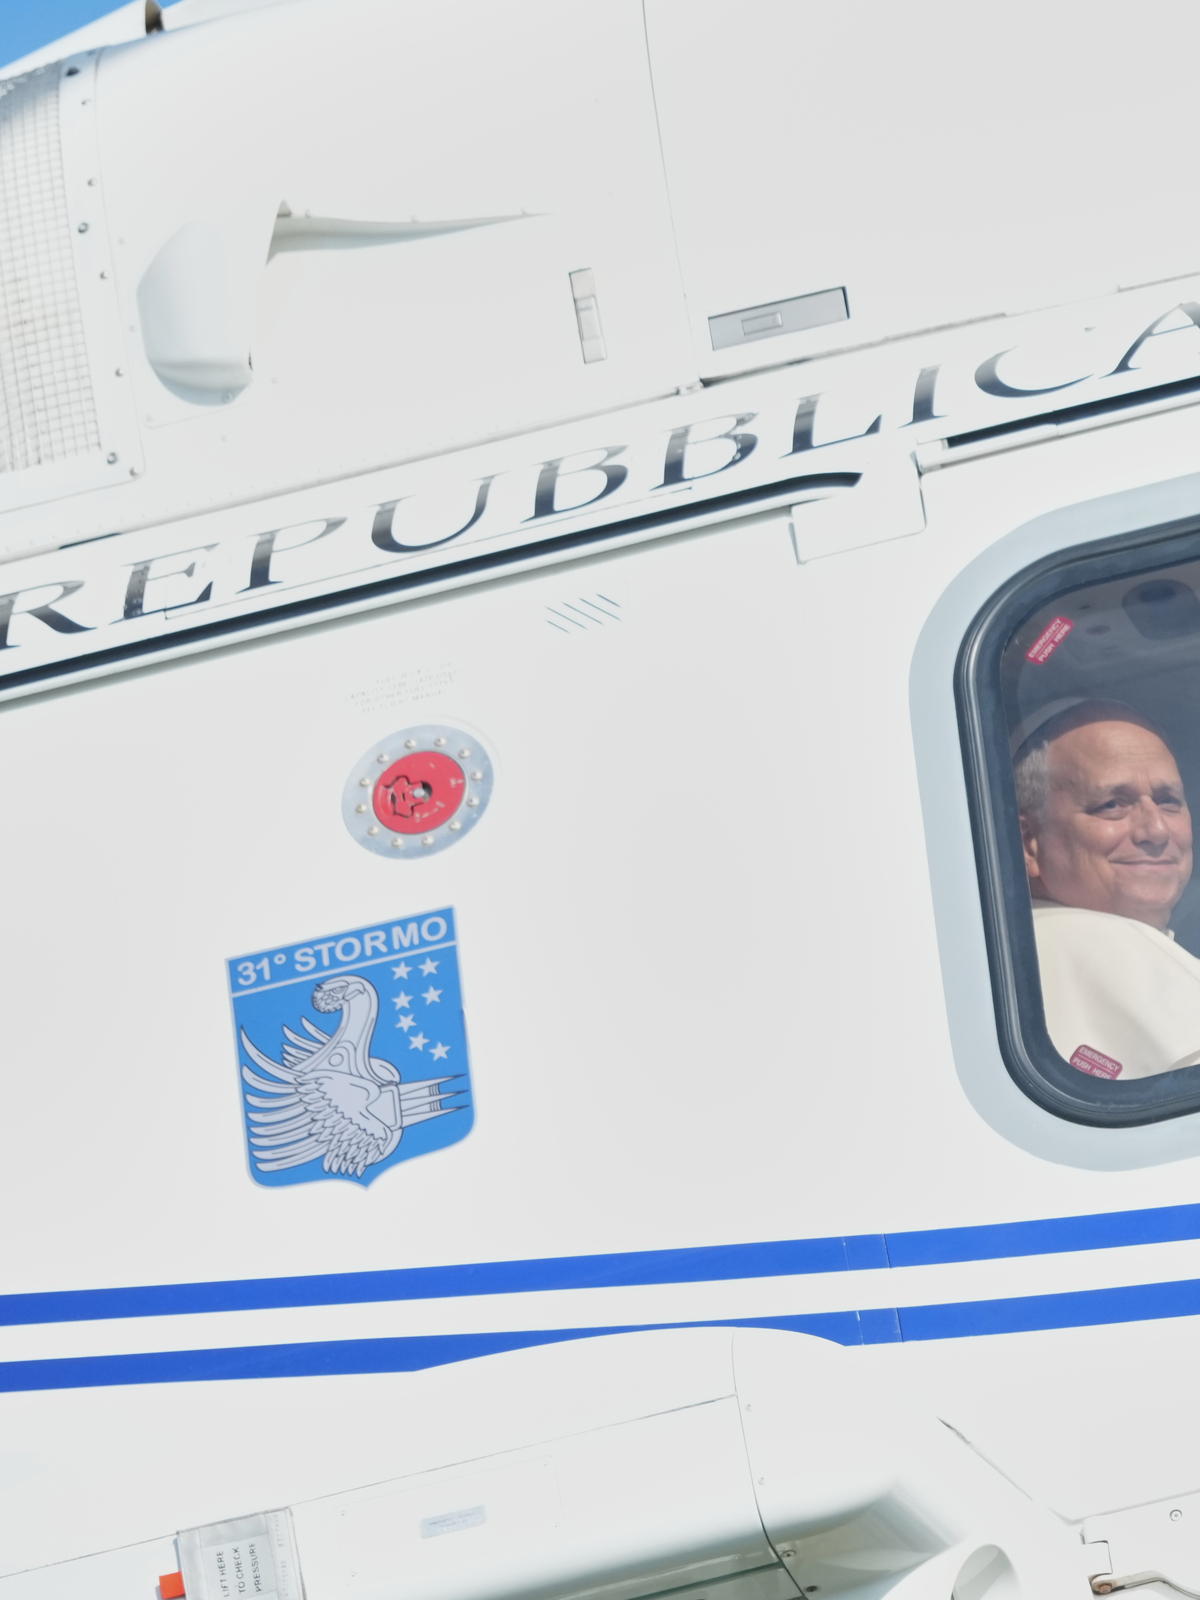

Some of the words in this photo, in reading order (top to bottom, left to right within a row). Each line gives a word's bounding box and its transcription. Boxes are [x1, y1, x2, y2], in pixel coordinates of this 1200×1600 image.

[1028, 618, 1061, 658] EMERGENCY
[1038, 643, 1055, 662] PUSH
[1053, 624, 1071, 643] HERE
[237, 953, 287, 986] 31°
[294, 916, 448, 972] STORMO
[1072, 1057, 1092, 1071] PUSH
[1079, 1045, 1120, 1072] EMERGENCY
[216, 1551, 226, 1576] HERE
[232, 1546, 244, 1580] CHECK
[248, 1542, 262, 1593] PRESSURE
[219, 1578, 230, 1598] LIFT
[238, 1581, 246, 1594] TO
